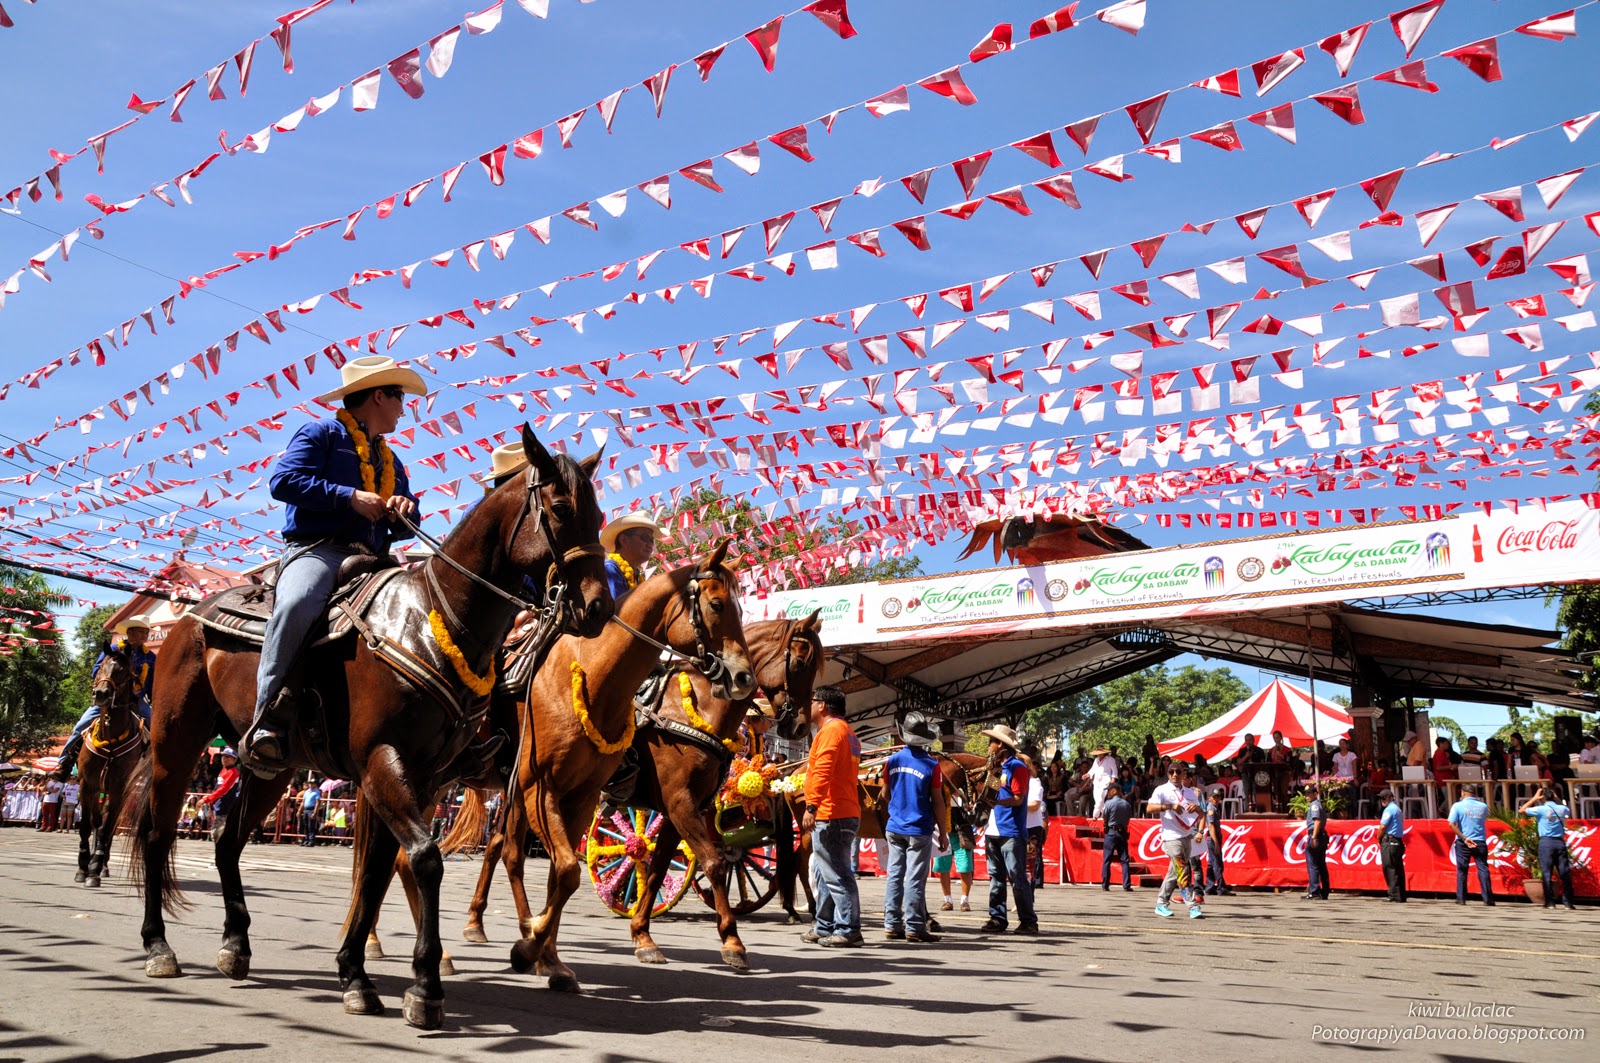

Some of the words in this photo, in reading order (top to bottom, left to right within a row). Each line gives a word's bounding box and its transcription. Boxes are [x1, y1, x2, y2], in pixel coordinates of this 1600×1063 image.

[1497, 519, 1580, 555] Coca-Cola
[1290, 539, 1421, 575] Kadayawan
[1353, 560, 1368, 568] SA
[1370, 557, 1408, 566] DABAW
[1090, 562, 1201, 596] Kadayawan
[1142, 582, 1154, 590] SA
[1156, 579, 1189, 588] DABAW
[1291, 578, 1308, 586] The
[1311, 575, 1345, 584] Festival
[1348, 573, 1359, 581] of
[1361, 571, 1402, 579] Festivals
[920, 583, 1014, 614] Kadayawan
[976, 598, 1004, 607] DABAW
[1107, 596, 1137, 605] Festival
[1149, 591, 1184, 600] Festivals
